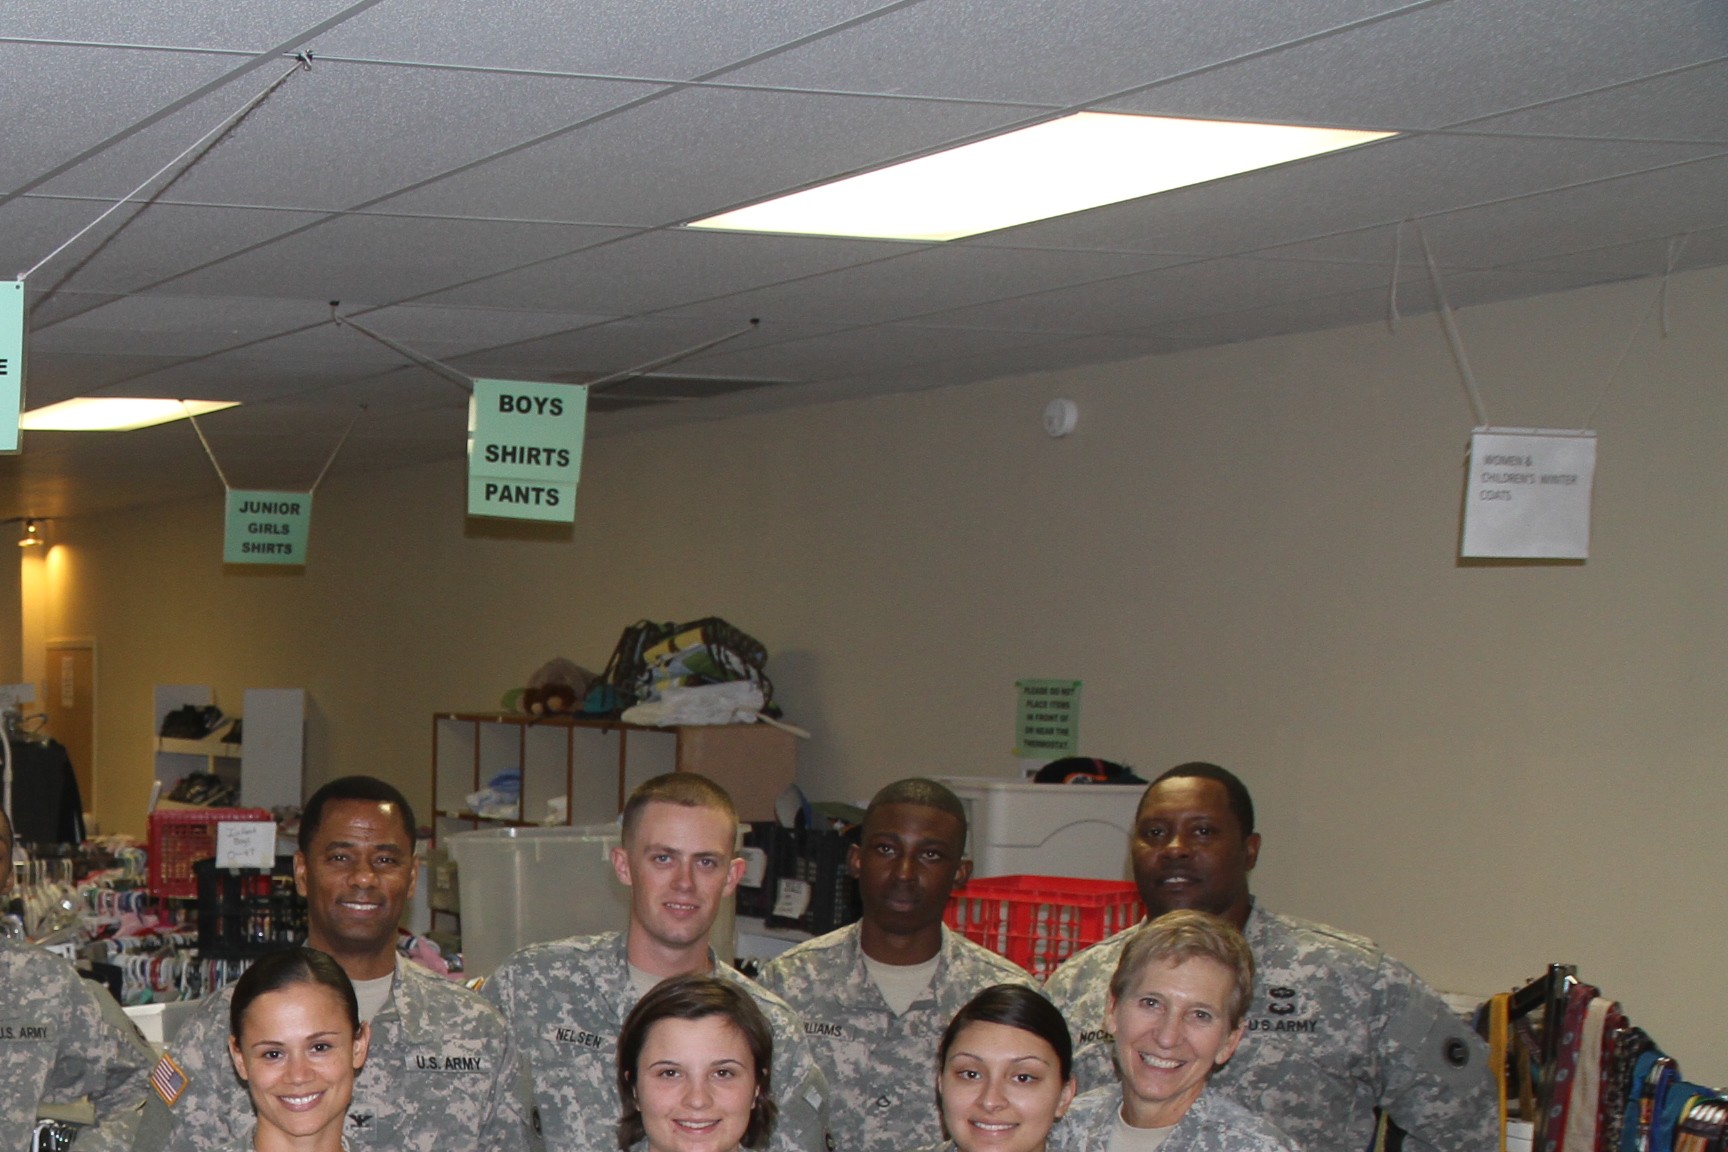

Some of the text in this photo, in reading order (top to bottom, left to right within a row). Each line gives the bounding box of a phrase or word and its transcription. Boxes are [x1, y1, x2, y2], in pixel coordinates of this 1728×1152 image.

[498, 394, 564, 417] BOYS
[484, 444, 570, 468] SHIRTS
[484, 483, 560, 506] PANTS
[238, 501, 301, 516] JUNIOR
[247, 523, 290, 536] GIRLS
[241, 541, 293, 556] SHIRTS
[20, 1026, 48, 1039] ARMY
[1275, 1020, 1318, 1033] ARMY
[555, 1027, 602, 1049] NELSEN
[416, 1055, 482, 1071] U.S. ARMY
